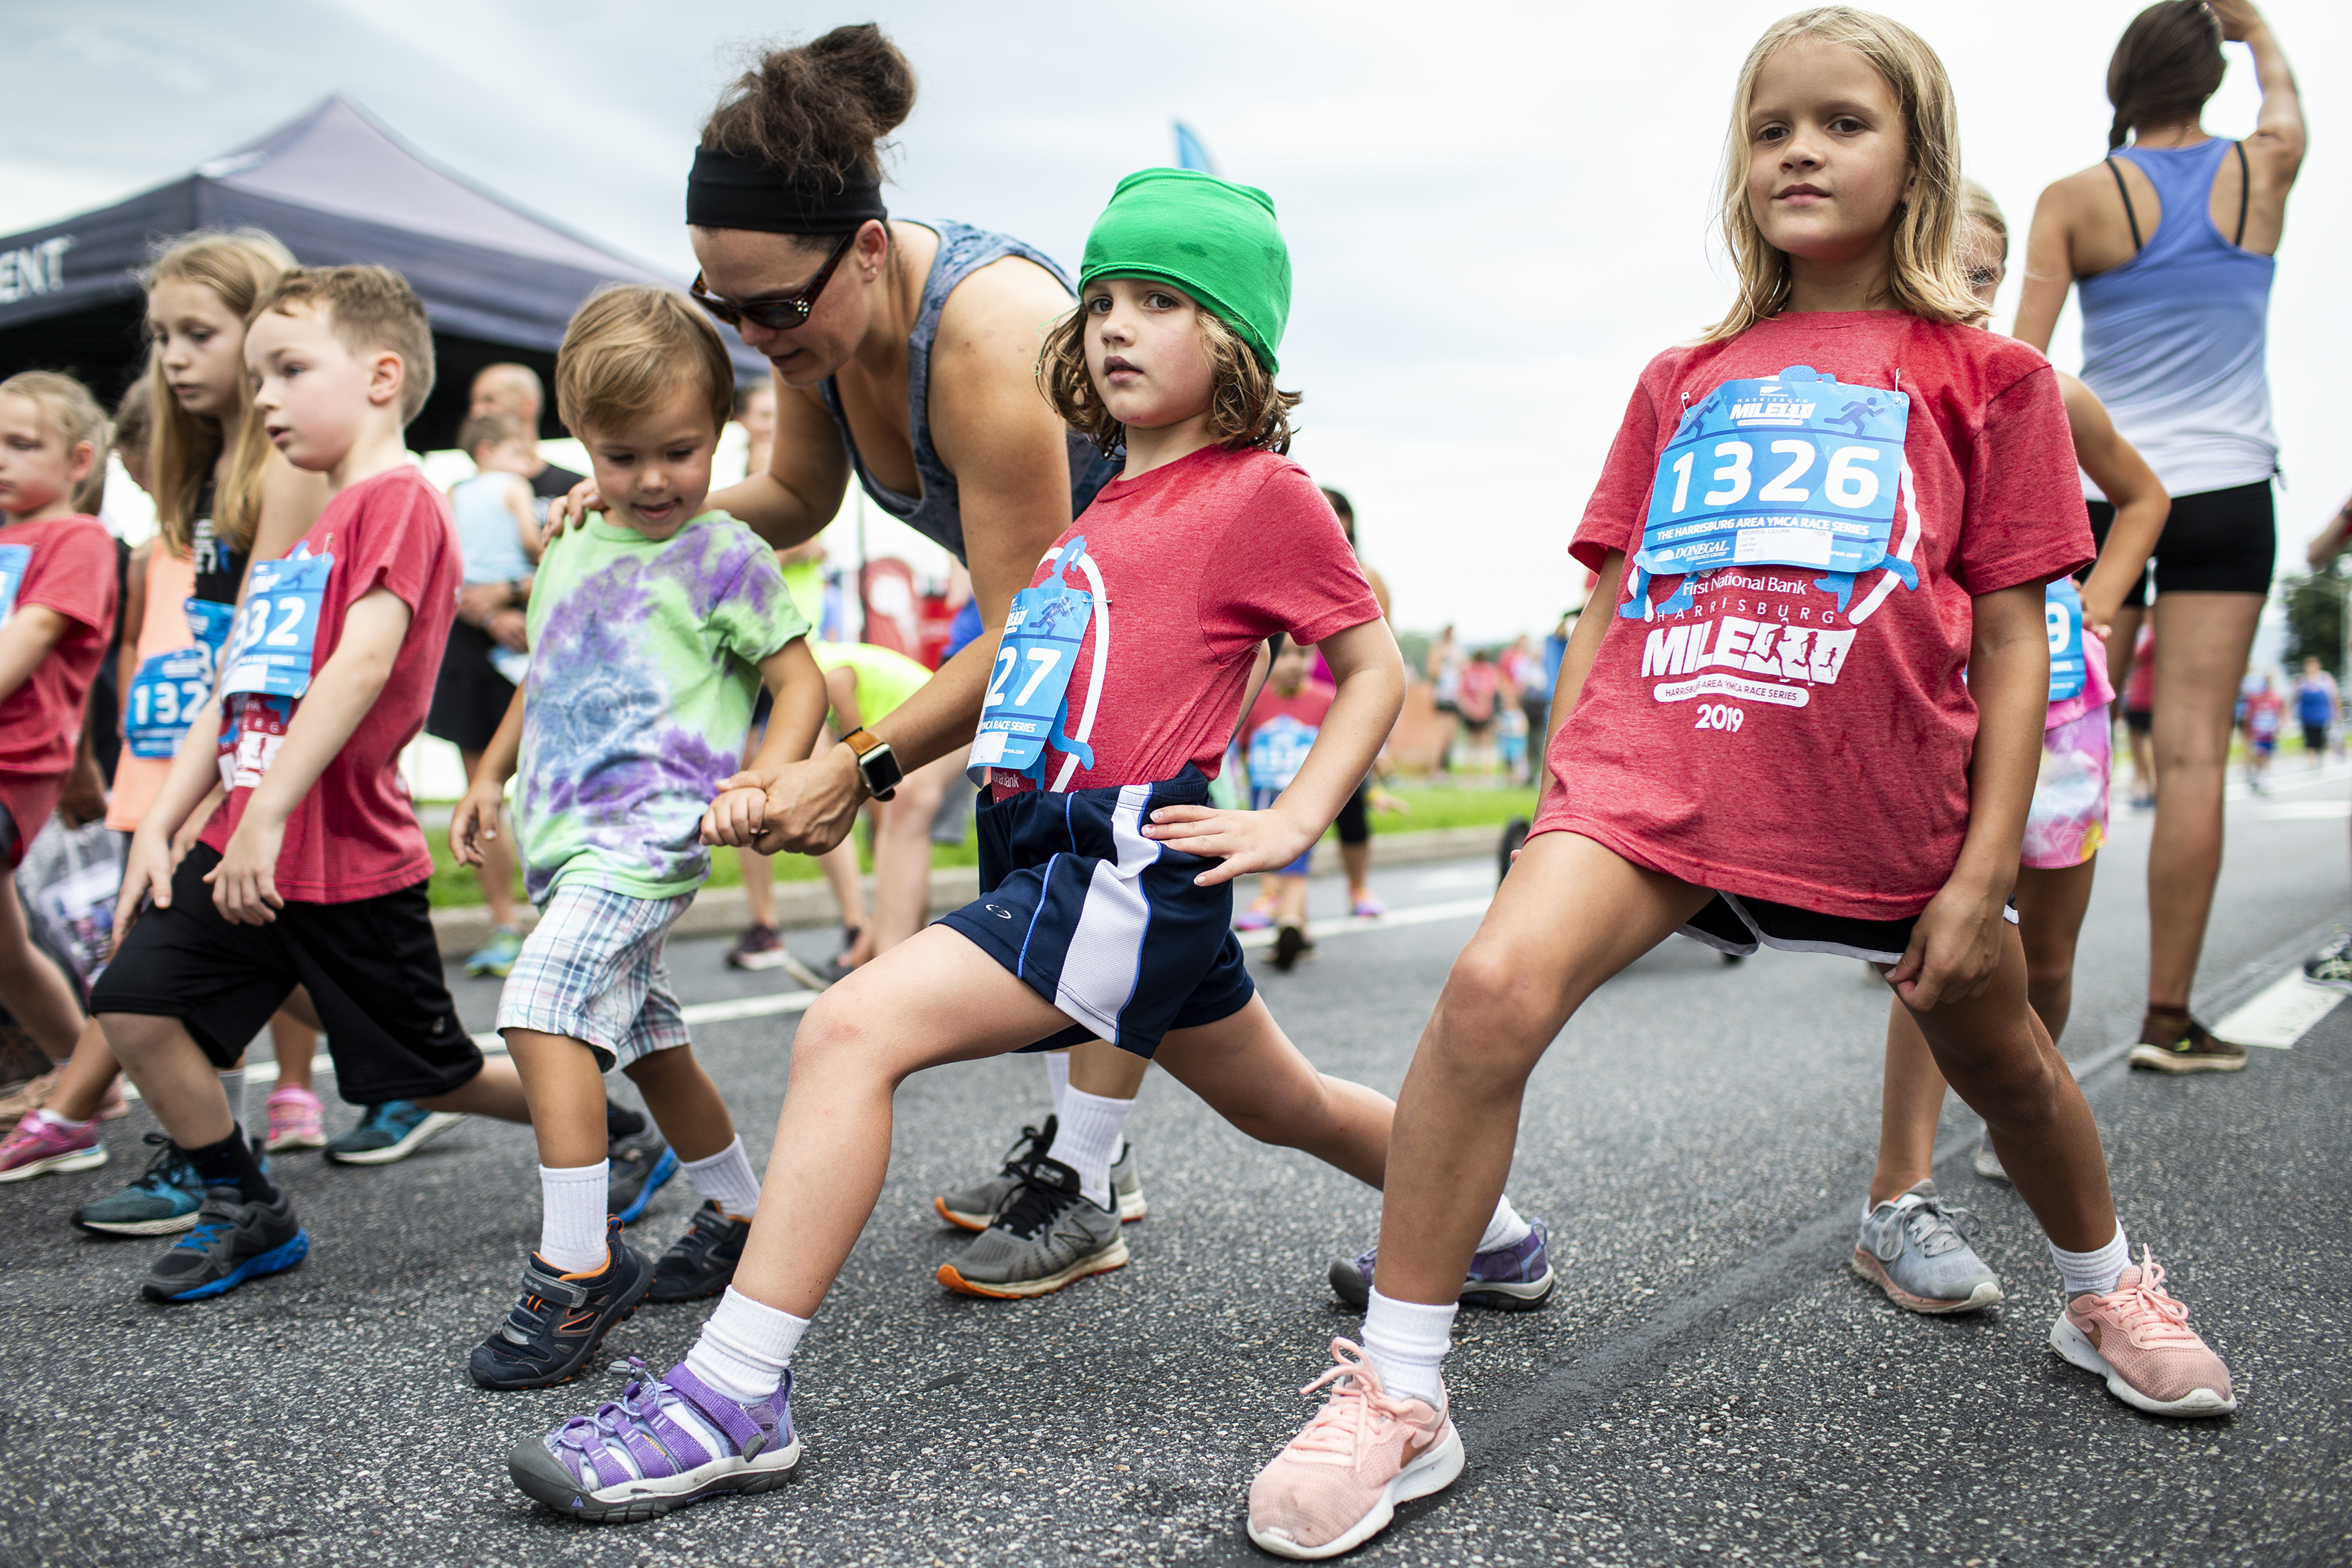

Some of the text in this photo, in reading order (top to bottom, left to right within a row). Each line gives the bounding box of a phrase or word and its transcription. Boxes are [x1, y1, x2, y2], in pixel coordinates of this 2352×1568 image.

[1671, 439, 1881, 513] 1326
[1656, 516, 1869, 542] THE HARRISBURG AREA YMCA RACE SERIES
[1686, 553, 1711, 562] INSURANCE
[1831, 550, 1862, 559] run.com
[1683, 572, 1807, 596] First National Bank
[1656, 597, 1835, 624] HARRISBURG
[2045, 602, 2070, 654] 9
[1641, 616, 1760, 679] MILE
[134, 679, 208, 726] 132
[1665, 679, 1797, 701] HARRISBURG AREA YMCA RACE SERIES
[993, 720, 1011, 730] RACE
[1010, 721, 1037, 733] SERIES
[1694, 703, 1744, 733] 2019
[1004, 772, 1020, 788] Bank
